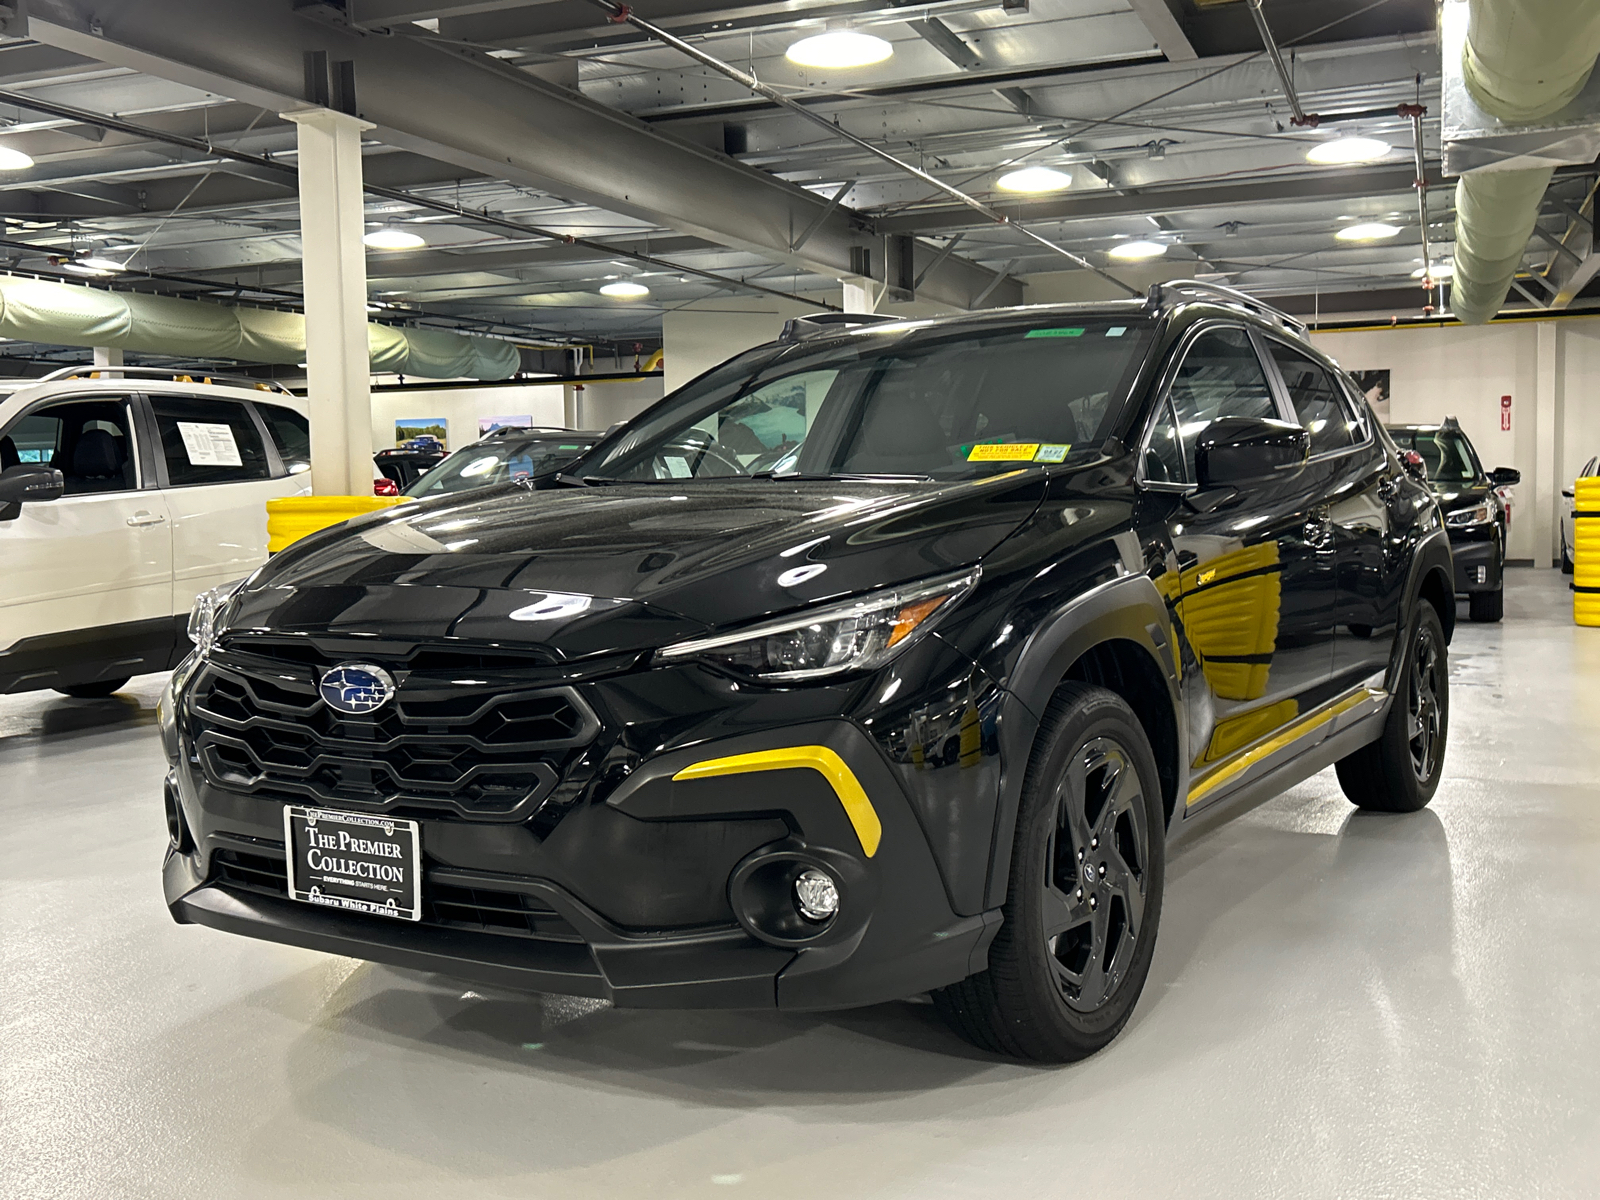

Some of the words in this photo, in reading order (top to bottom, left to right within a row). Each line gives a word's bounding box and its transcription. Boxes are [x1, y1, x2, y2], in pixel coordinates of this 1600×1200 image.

[305, 826, 338, 850] THE
[338, 830, 403, 859] PREMIER
[307, 848, 404, 883] COLLECTION
[323, 875, 355, 887] EVERYTHING
[355, 880, 374, 890] STARTS
[308, 894, 340, 906] Subaru
[341, 899, 368, 912] White
[370, 904, 399, 917] Plains
